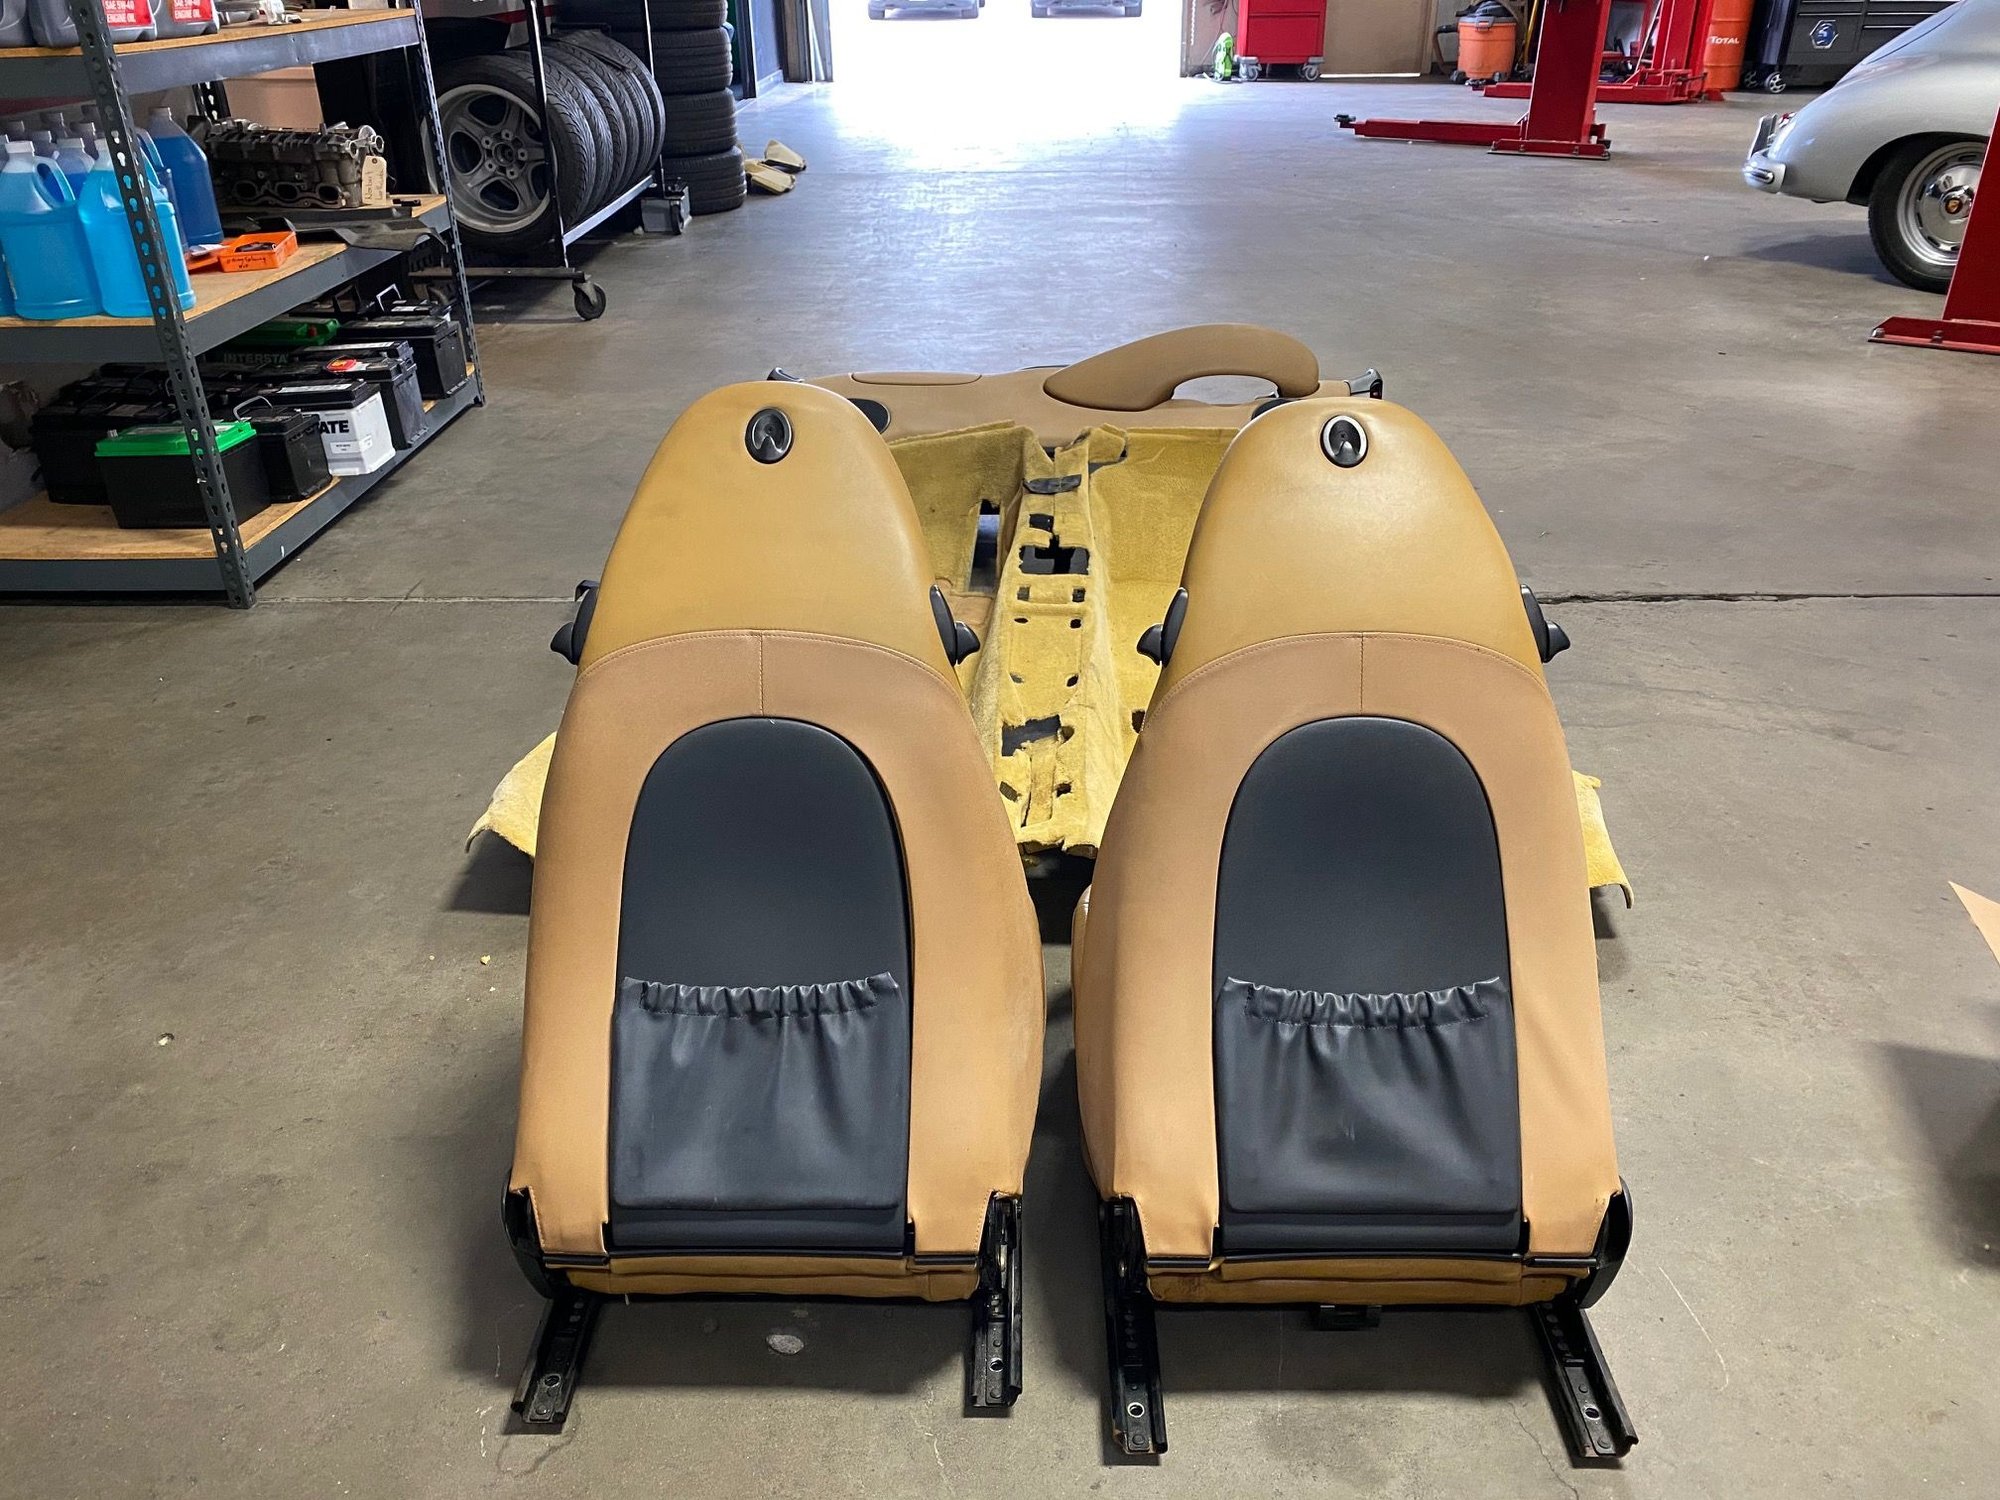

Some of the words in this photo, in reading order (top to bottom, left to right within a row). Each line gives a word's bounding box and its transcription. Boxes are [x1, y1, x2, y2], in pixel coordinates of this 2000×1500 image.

[106, 13, 127, 23] ENGINE
[127, 12, 136, 22] OIL
[174, 9, 193, 19] ENGINE
[193, 9, 202, 17] OIL
[1711, 35, 1740, 45] TOTAL
[224, 352, 289, 364] INTERSTA
